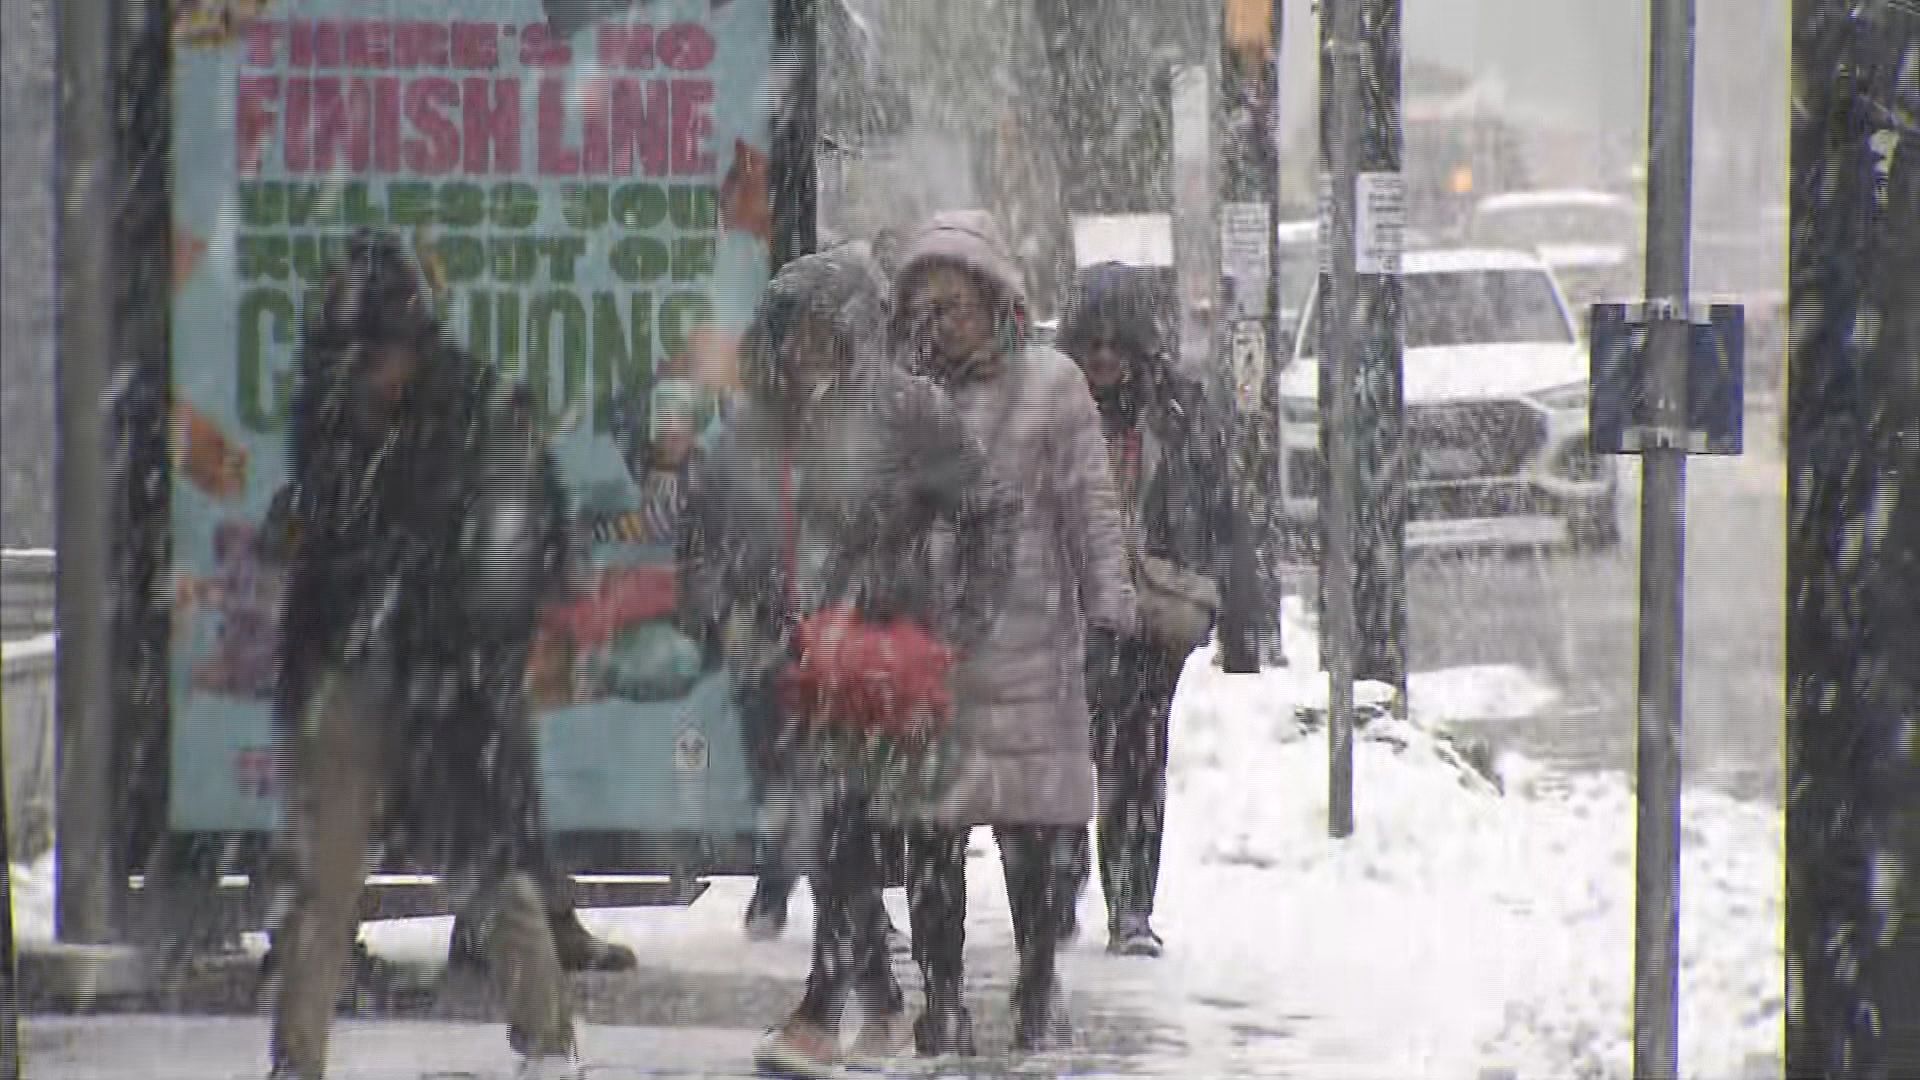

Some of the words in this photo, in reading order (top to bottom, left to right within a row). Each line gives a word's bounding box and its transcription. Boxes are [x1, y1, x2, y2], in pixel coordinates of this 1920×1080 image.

[598, 23, 716, 71] NO
[237, 77, 521, 174] FINISH
[538, 78, 717, 176] LINE
[238, 181, 538, 227] UNLESS
[560, 182, 717, 228] YOU
[428, 235, 587, 281] OUT
